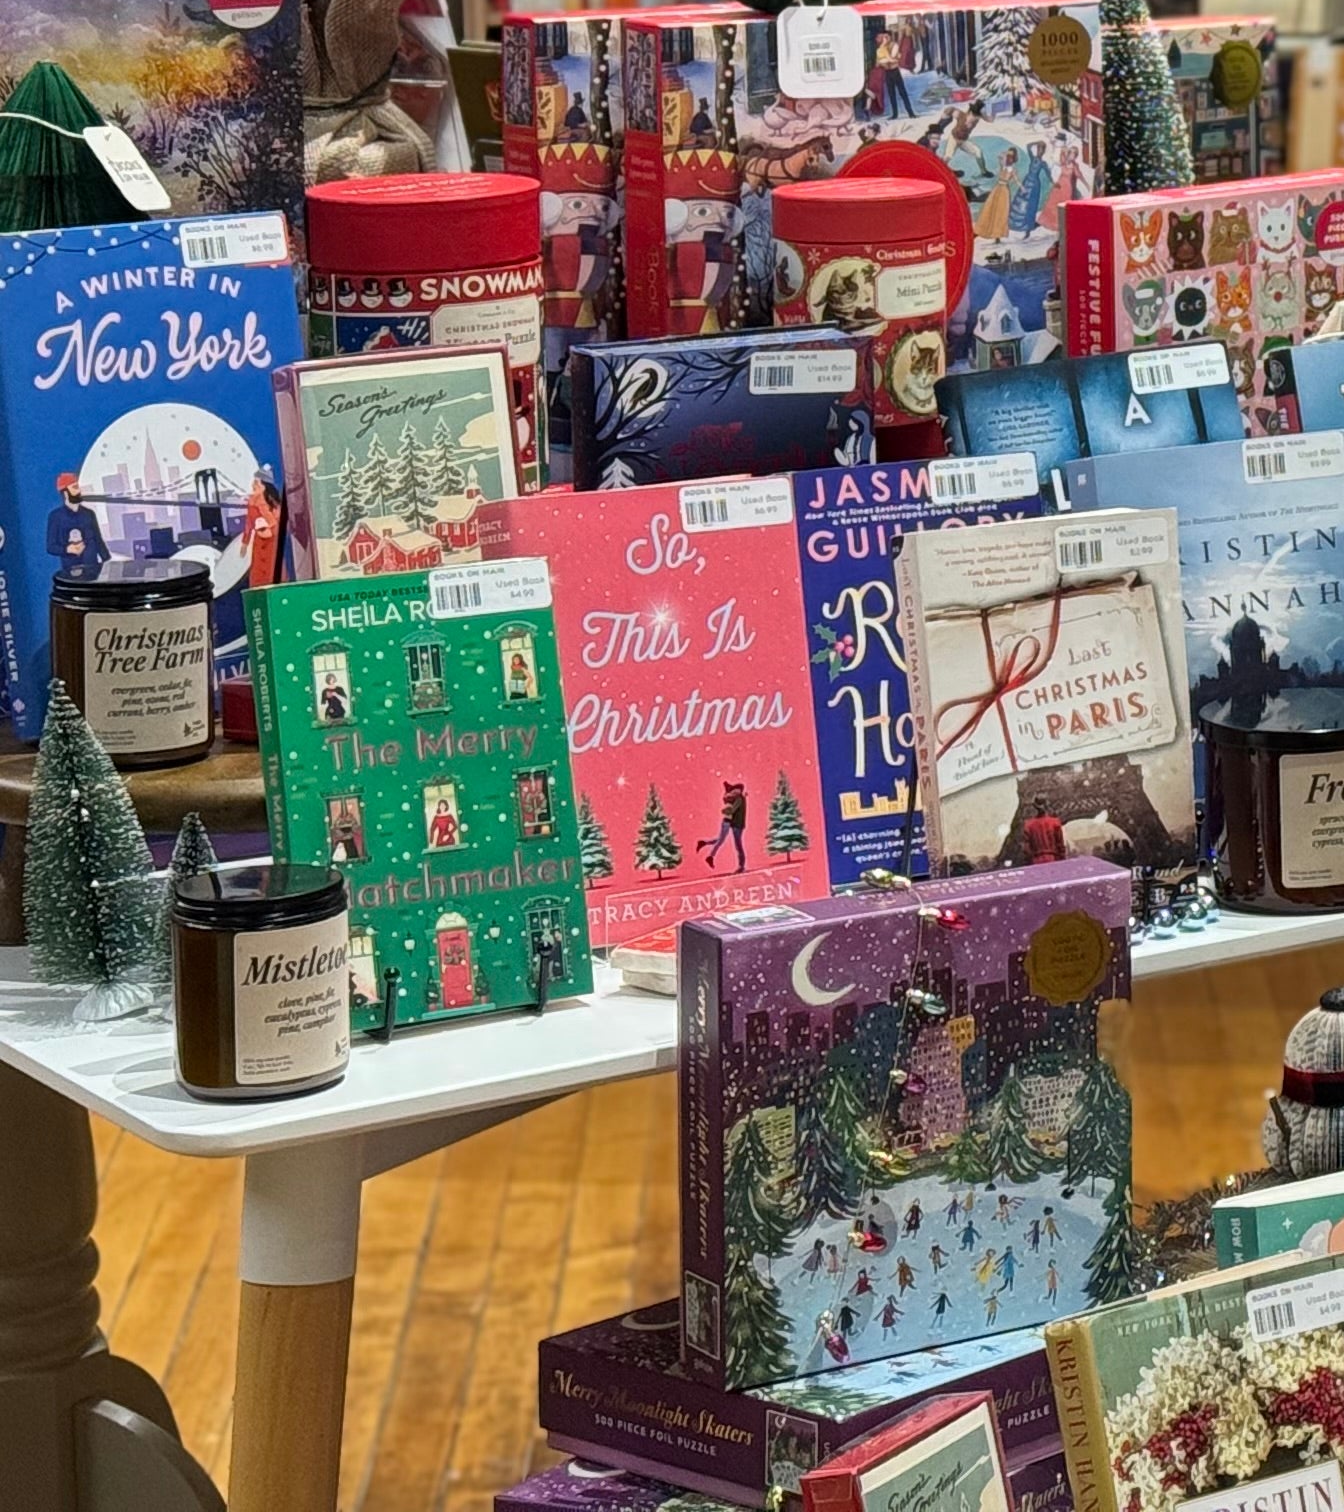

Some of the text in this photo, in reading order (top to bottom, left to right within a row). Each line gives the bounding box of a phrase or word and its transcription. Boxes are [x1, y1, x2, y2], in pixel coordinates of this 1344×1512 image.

[1040, 31, 1078, 47] 1000
[55, 266, 242, 314] A WINTER IN
[420, 271, 544, 301] SNOWMAN
[1088, 239, 1102, 325] FESTIVE
[34, 311, 272, 390] New York
[319, 385, 397, 417] Season's
[355, 389, 448, 439] Greetings
[808, 468, 930, 509] JASM
[626, 514, 706, 575] So,
[1179, 526, 1338, 566] ISTIN
[312, 602, 402, 632] SHEILA
[1182, 580, 1343, 621] ANNAH
[4, 621, 19, 682] SILVER
[94, 624, 204, 651] Christmas
[582, 608, 690, 669] This
[703, 598, 756, 660] Is
[1068, 639, 1113, 666] Last
[95, 650, 147, 674] Tree
[150, 647, 204, 672] Farm
[251, 607, 266, 662] SHEILA
[259, 663, 273, 733] ROBERTS
[904, 595, 932, 789] CHRISTMAS PARIS
[1015, 661, 1149, 711] CHRISTMAS
[568, 690, 793, 754] Christmas
[1017, 692, 1150, 741] in PARIS
[325, 725, 538, 772] The Merry
[346, 849, 576, 911] atchmaker
[588, 882, 794, 925] TRACY ANDREEN
[551, 1370, 755, 1446] Merry Moonlight Skaters
[1056, 1339, 1089, 1446] KRISTIN
[595, 1413, 717, 1457] 500 PIECE FOIL PUZZLE
[1007, 1404, 1051, 1429] PUZZLE
[888, 1472, 933, 1511] Season's
